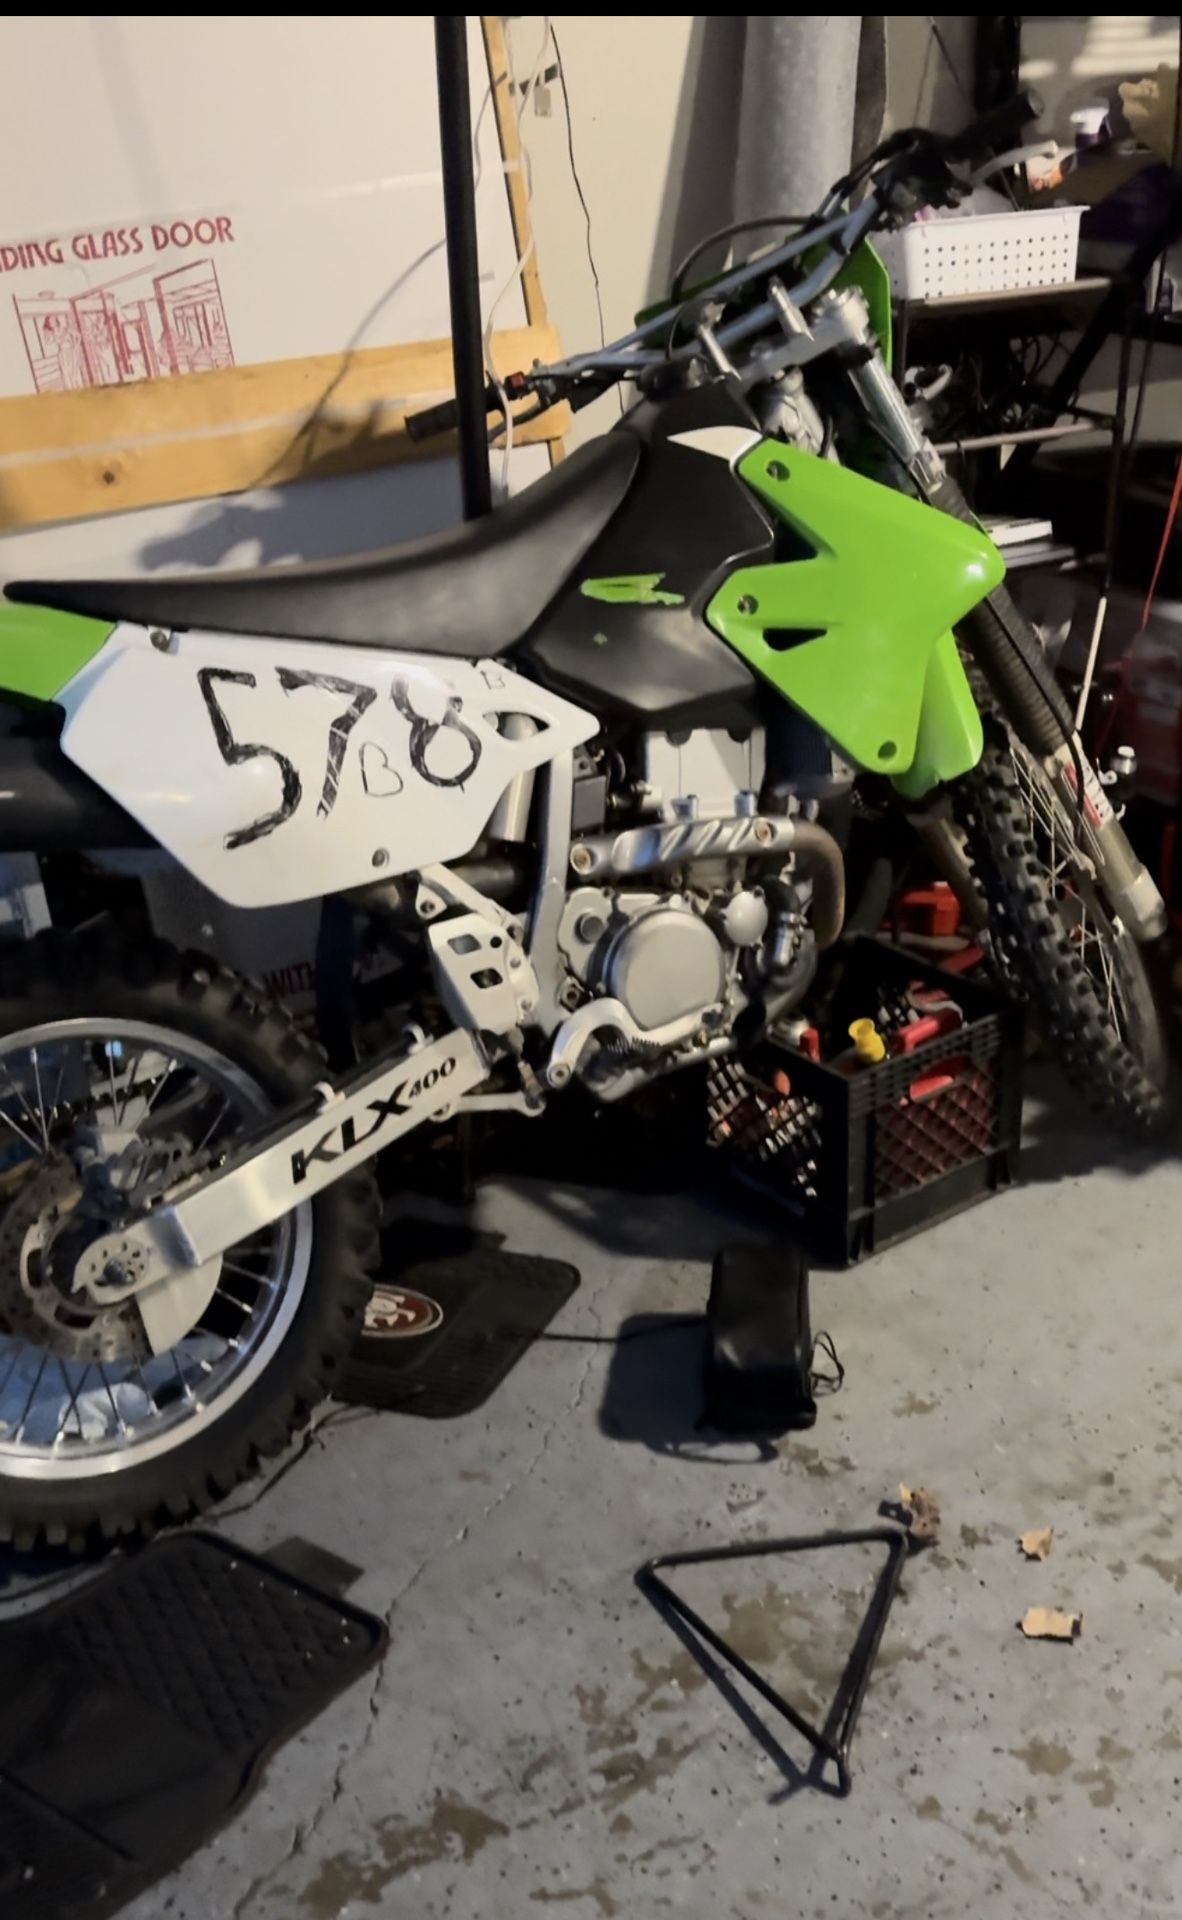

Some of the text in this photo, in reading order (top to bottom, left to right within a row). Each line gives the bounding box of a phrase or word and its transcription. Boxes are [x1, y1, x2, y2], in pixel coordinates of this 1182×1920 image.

[0, 217, 235, 273] DING GLASS DOOR
[197, 667, 481, 850] 578
